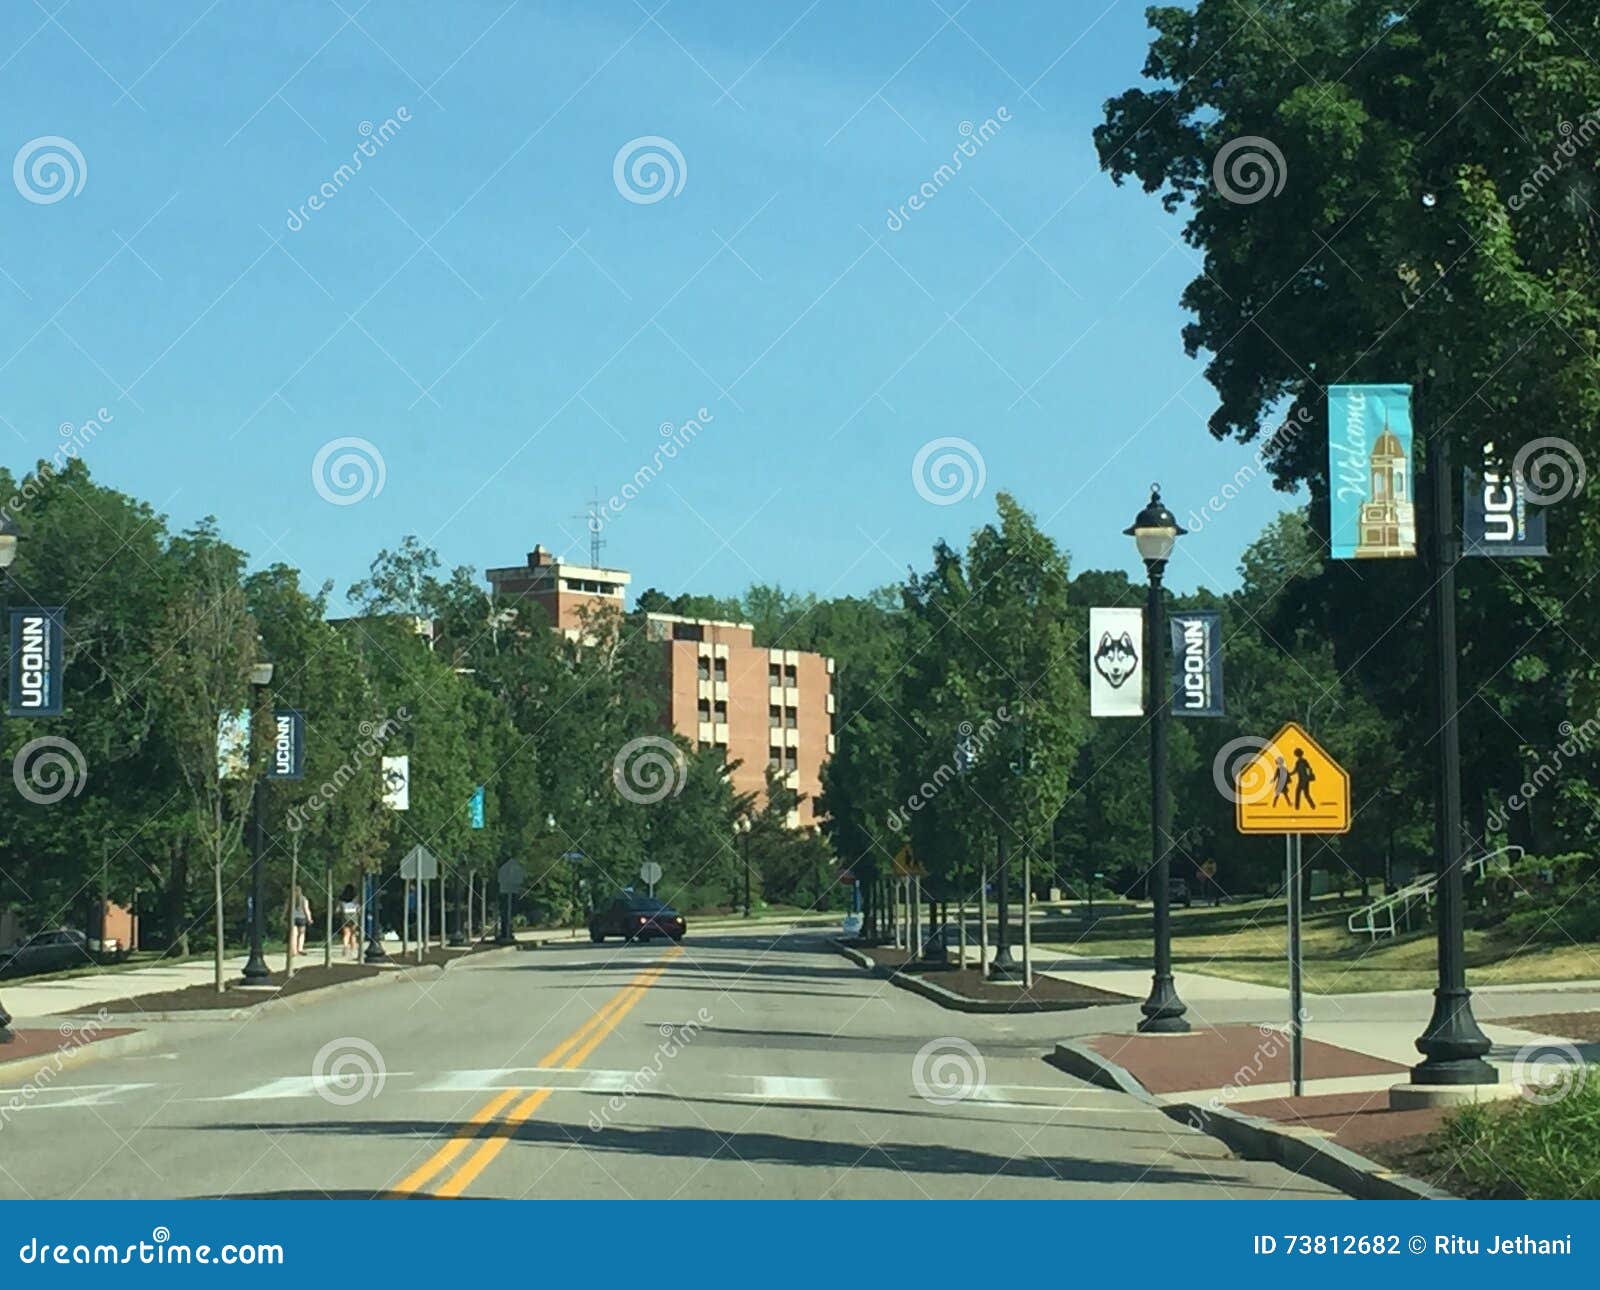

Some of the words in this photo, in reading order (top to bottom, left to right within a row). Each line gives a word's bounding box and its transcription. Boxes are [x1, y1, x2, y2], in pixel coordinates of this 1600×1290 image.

[1331, 388, 1368, 503] Welcome
[21, 617, 43, 707] UCONN
[1183, 619, 1204, 708] UCONN
[276, 716, 290, 774] UCONN
